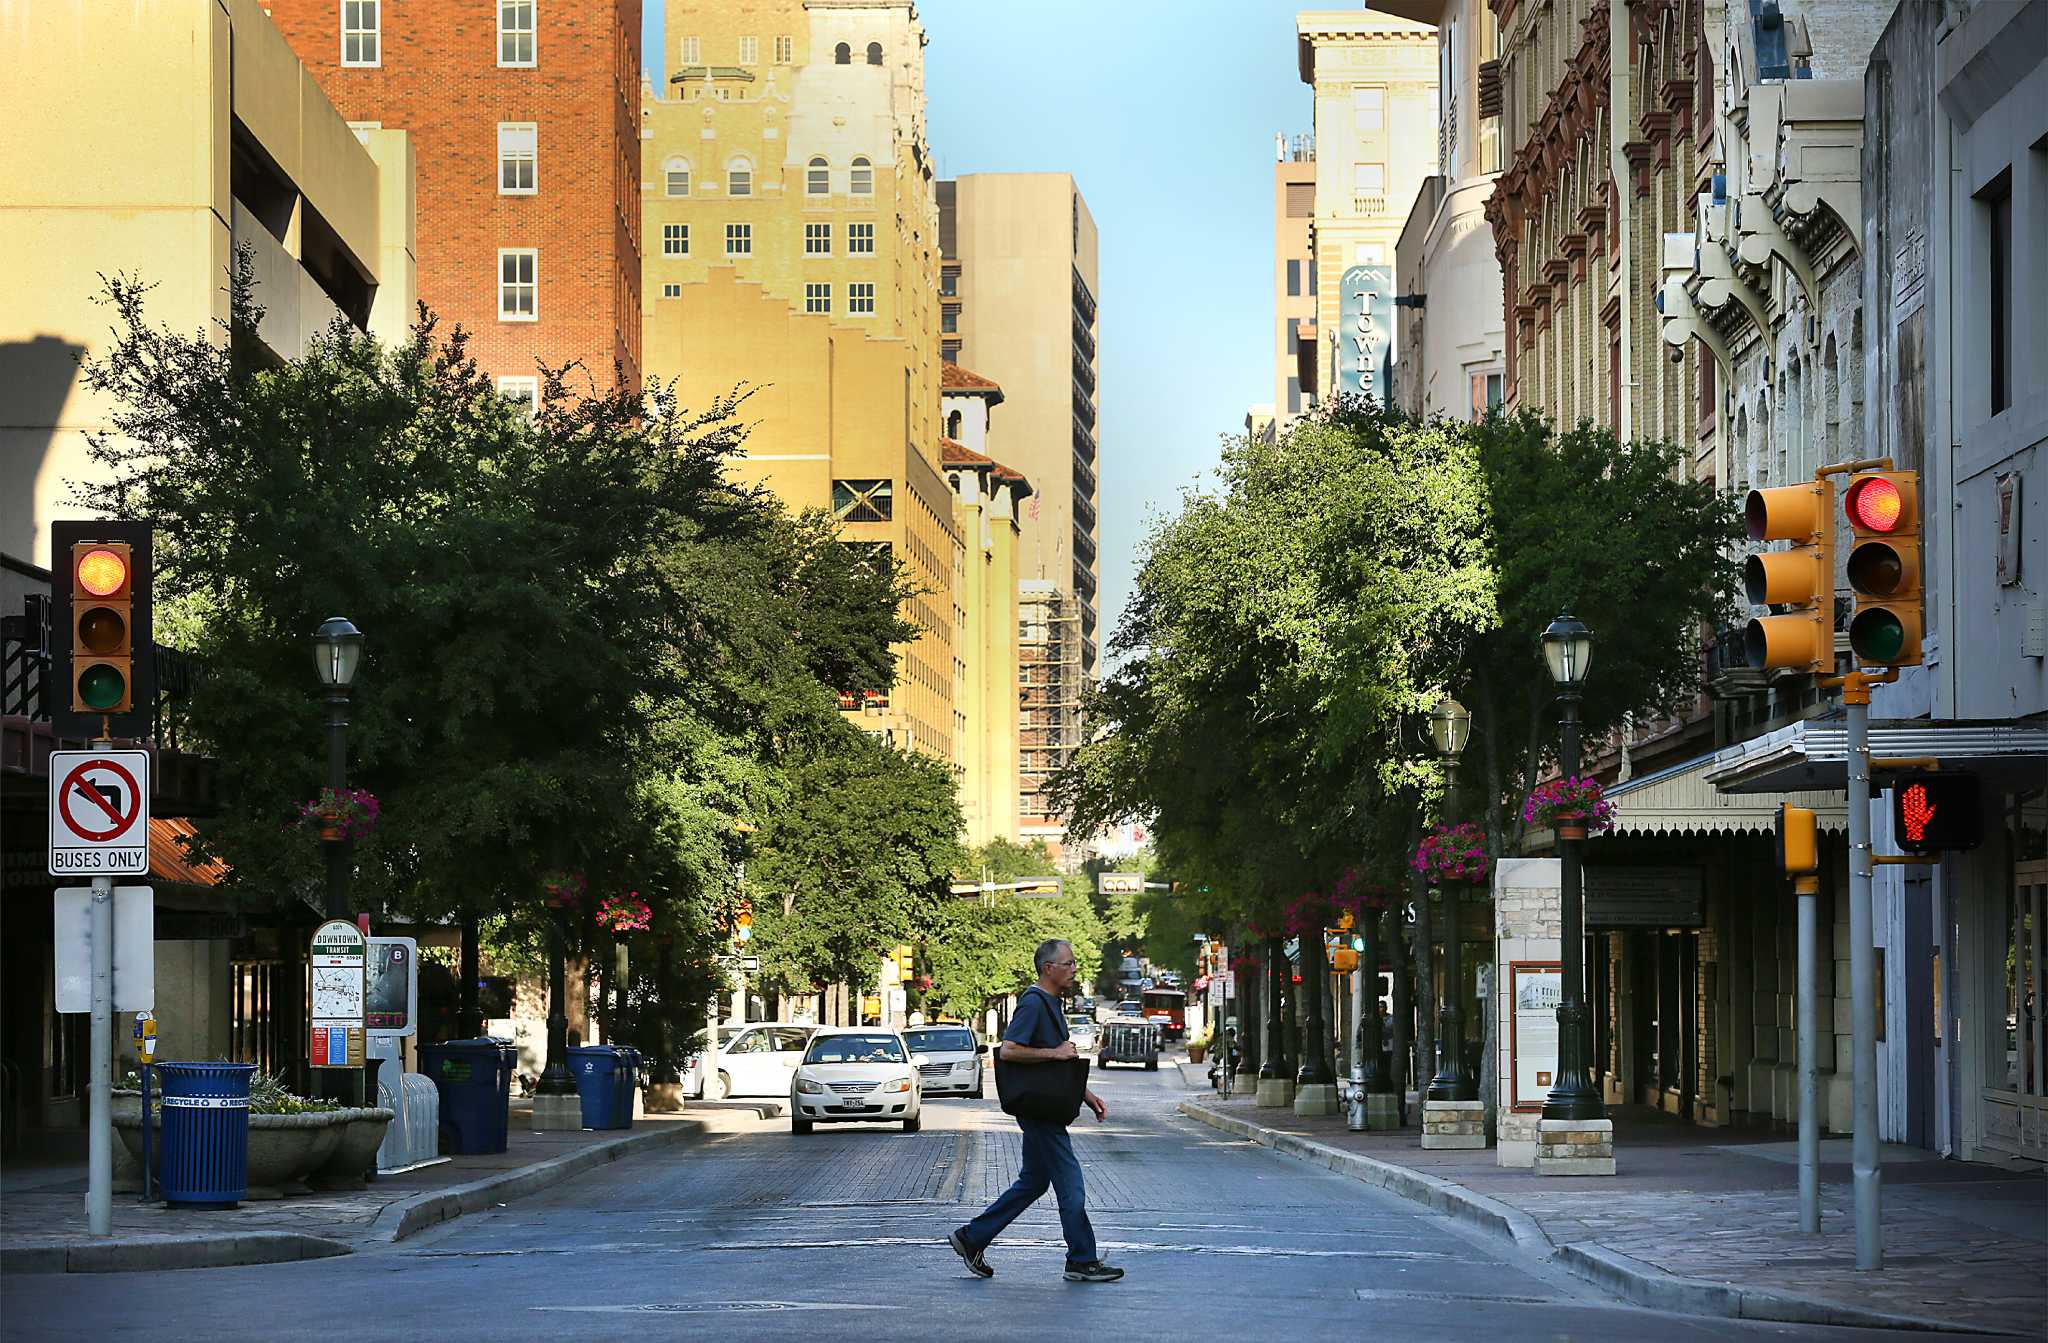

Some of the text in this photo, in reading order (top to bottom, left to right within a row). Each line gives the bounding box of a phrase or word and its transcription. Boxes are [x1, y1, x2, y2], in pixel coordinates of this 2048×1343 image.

[1353, 291, 1379, 391] Towne
[55, 851, 143, 868] BUSES ONLY
[317, 935, 358, 944] DOWNTOWN
[326, 946, 350, 954] TRANSIT
[394, 950, 402, 960] B
[166, 1098, 200, 1107] RECYCLE
